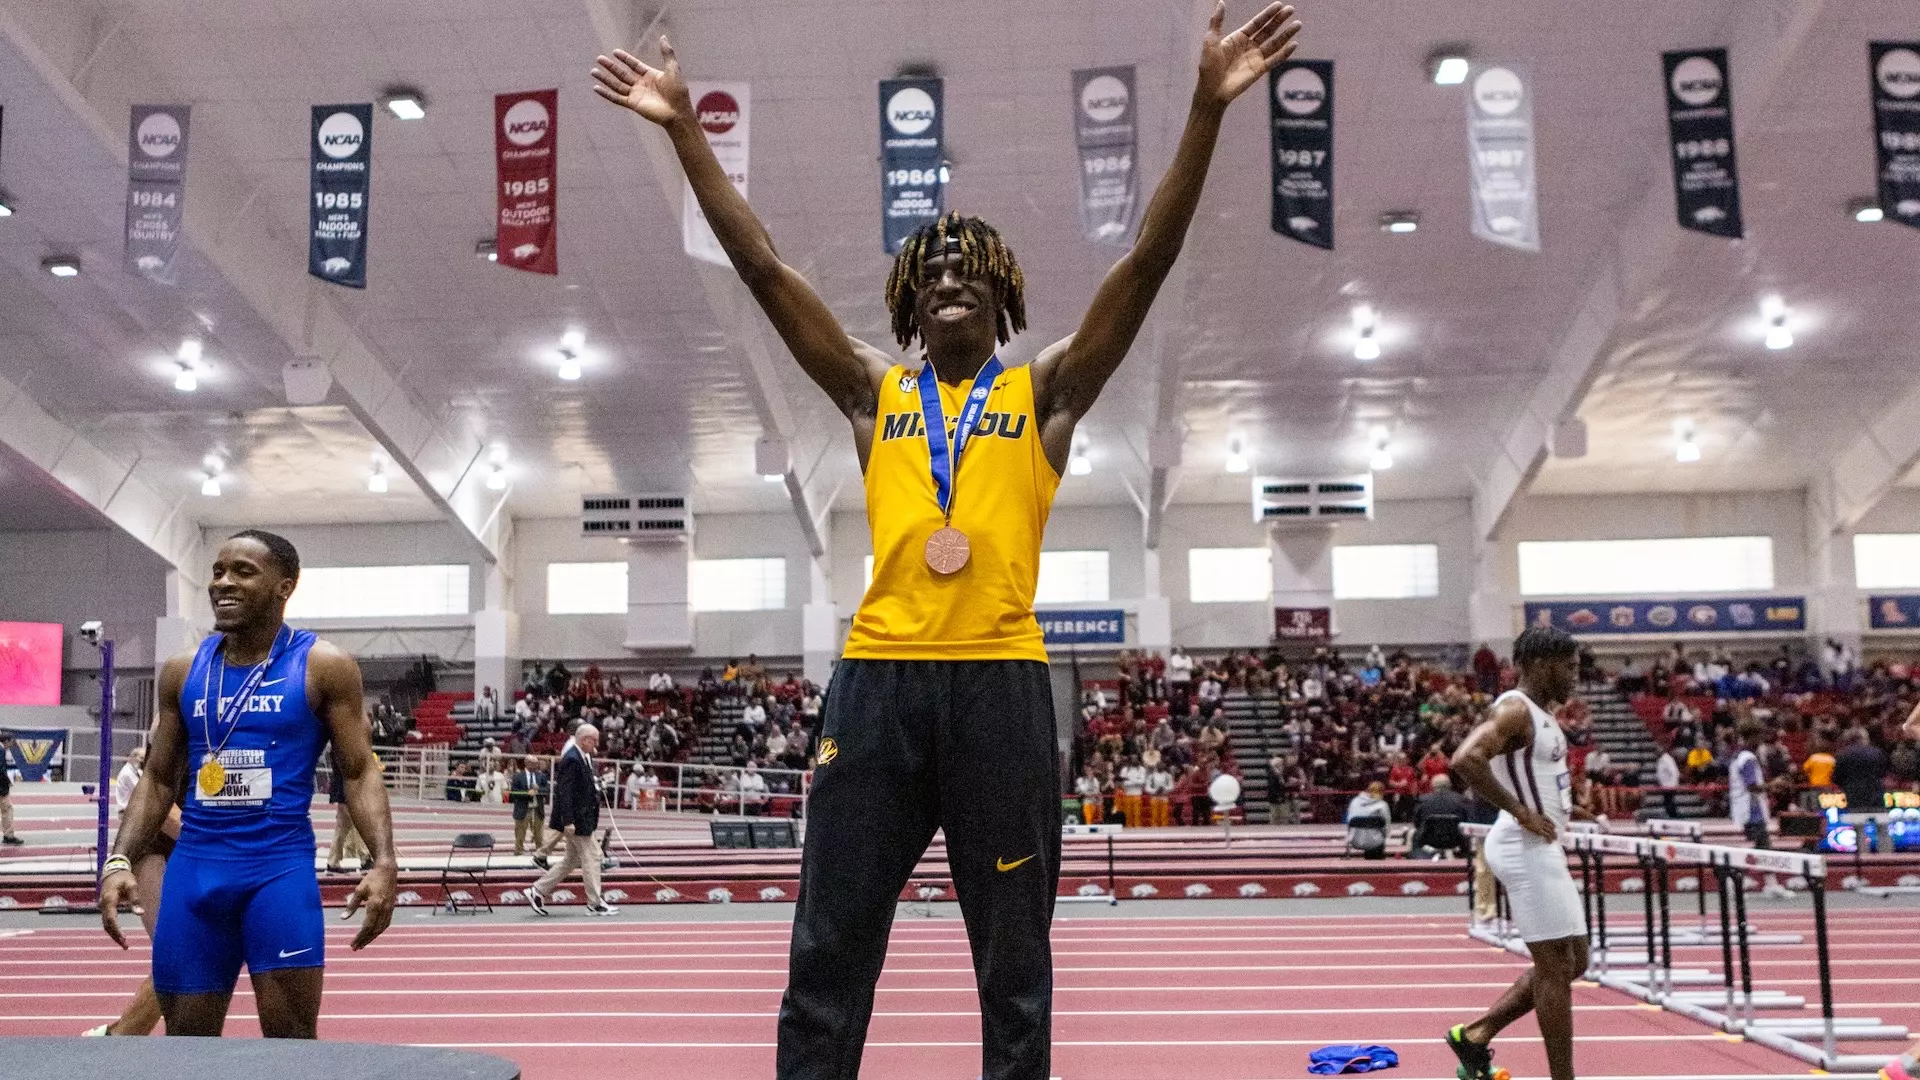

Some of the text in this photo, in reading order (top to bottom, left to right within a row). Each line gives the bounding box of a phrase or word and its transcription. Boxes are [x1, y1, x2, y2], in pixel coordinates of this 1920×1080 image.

[895, 110, 933, 121] NCAA
[509, 121, 547, 134] NCAA
[142, 134, 178, 145] NCAA
[324, 134, 361, 146] NCAA
[1085, 155, 1132, 173] 1986
[1278, 150, 1326, 168] 1987
[316, 162, 365, 171] CHAMPIONS
[887, 169, 936, 186] 1986
[504, 177, 549, 197] 1985
[133, 191, 176, 208] 1984
[315, 192, 363, 209] 1985
[502, 206, 549, 219] OUTDOOR
[318, 220, 358, 231] INDOOR
[882, 412, 1027, 441] MIOU
[1041, 620, 1119, 633] FERENCE
[224, 773, 243, 784] UKE
[214, 785, 250, 796] ROWN
